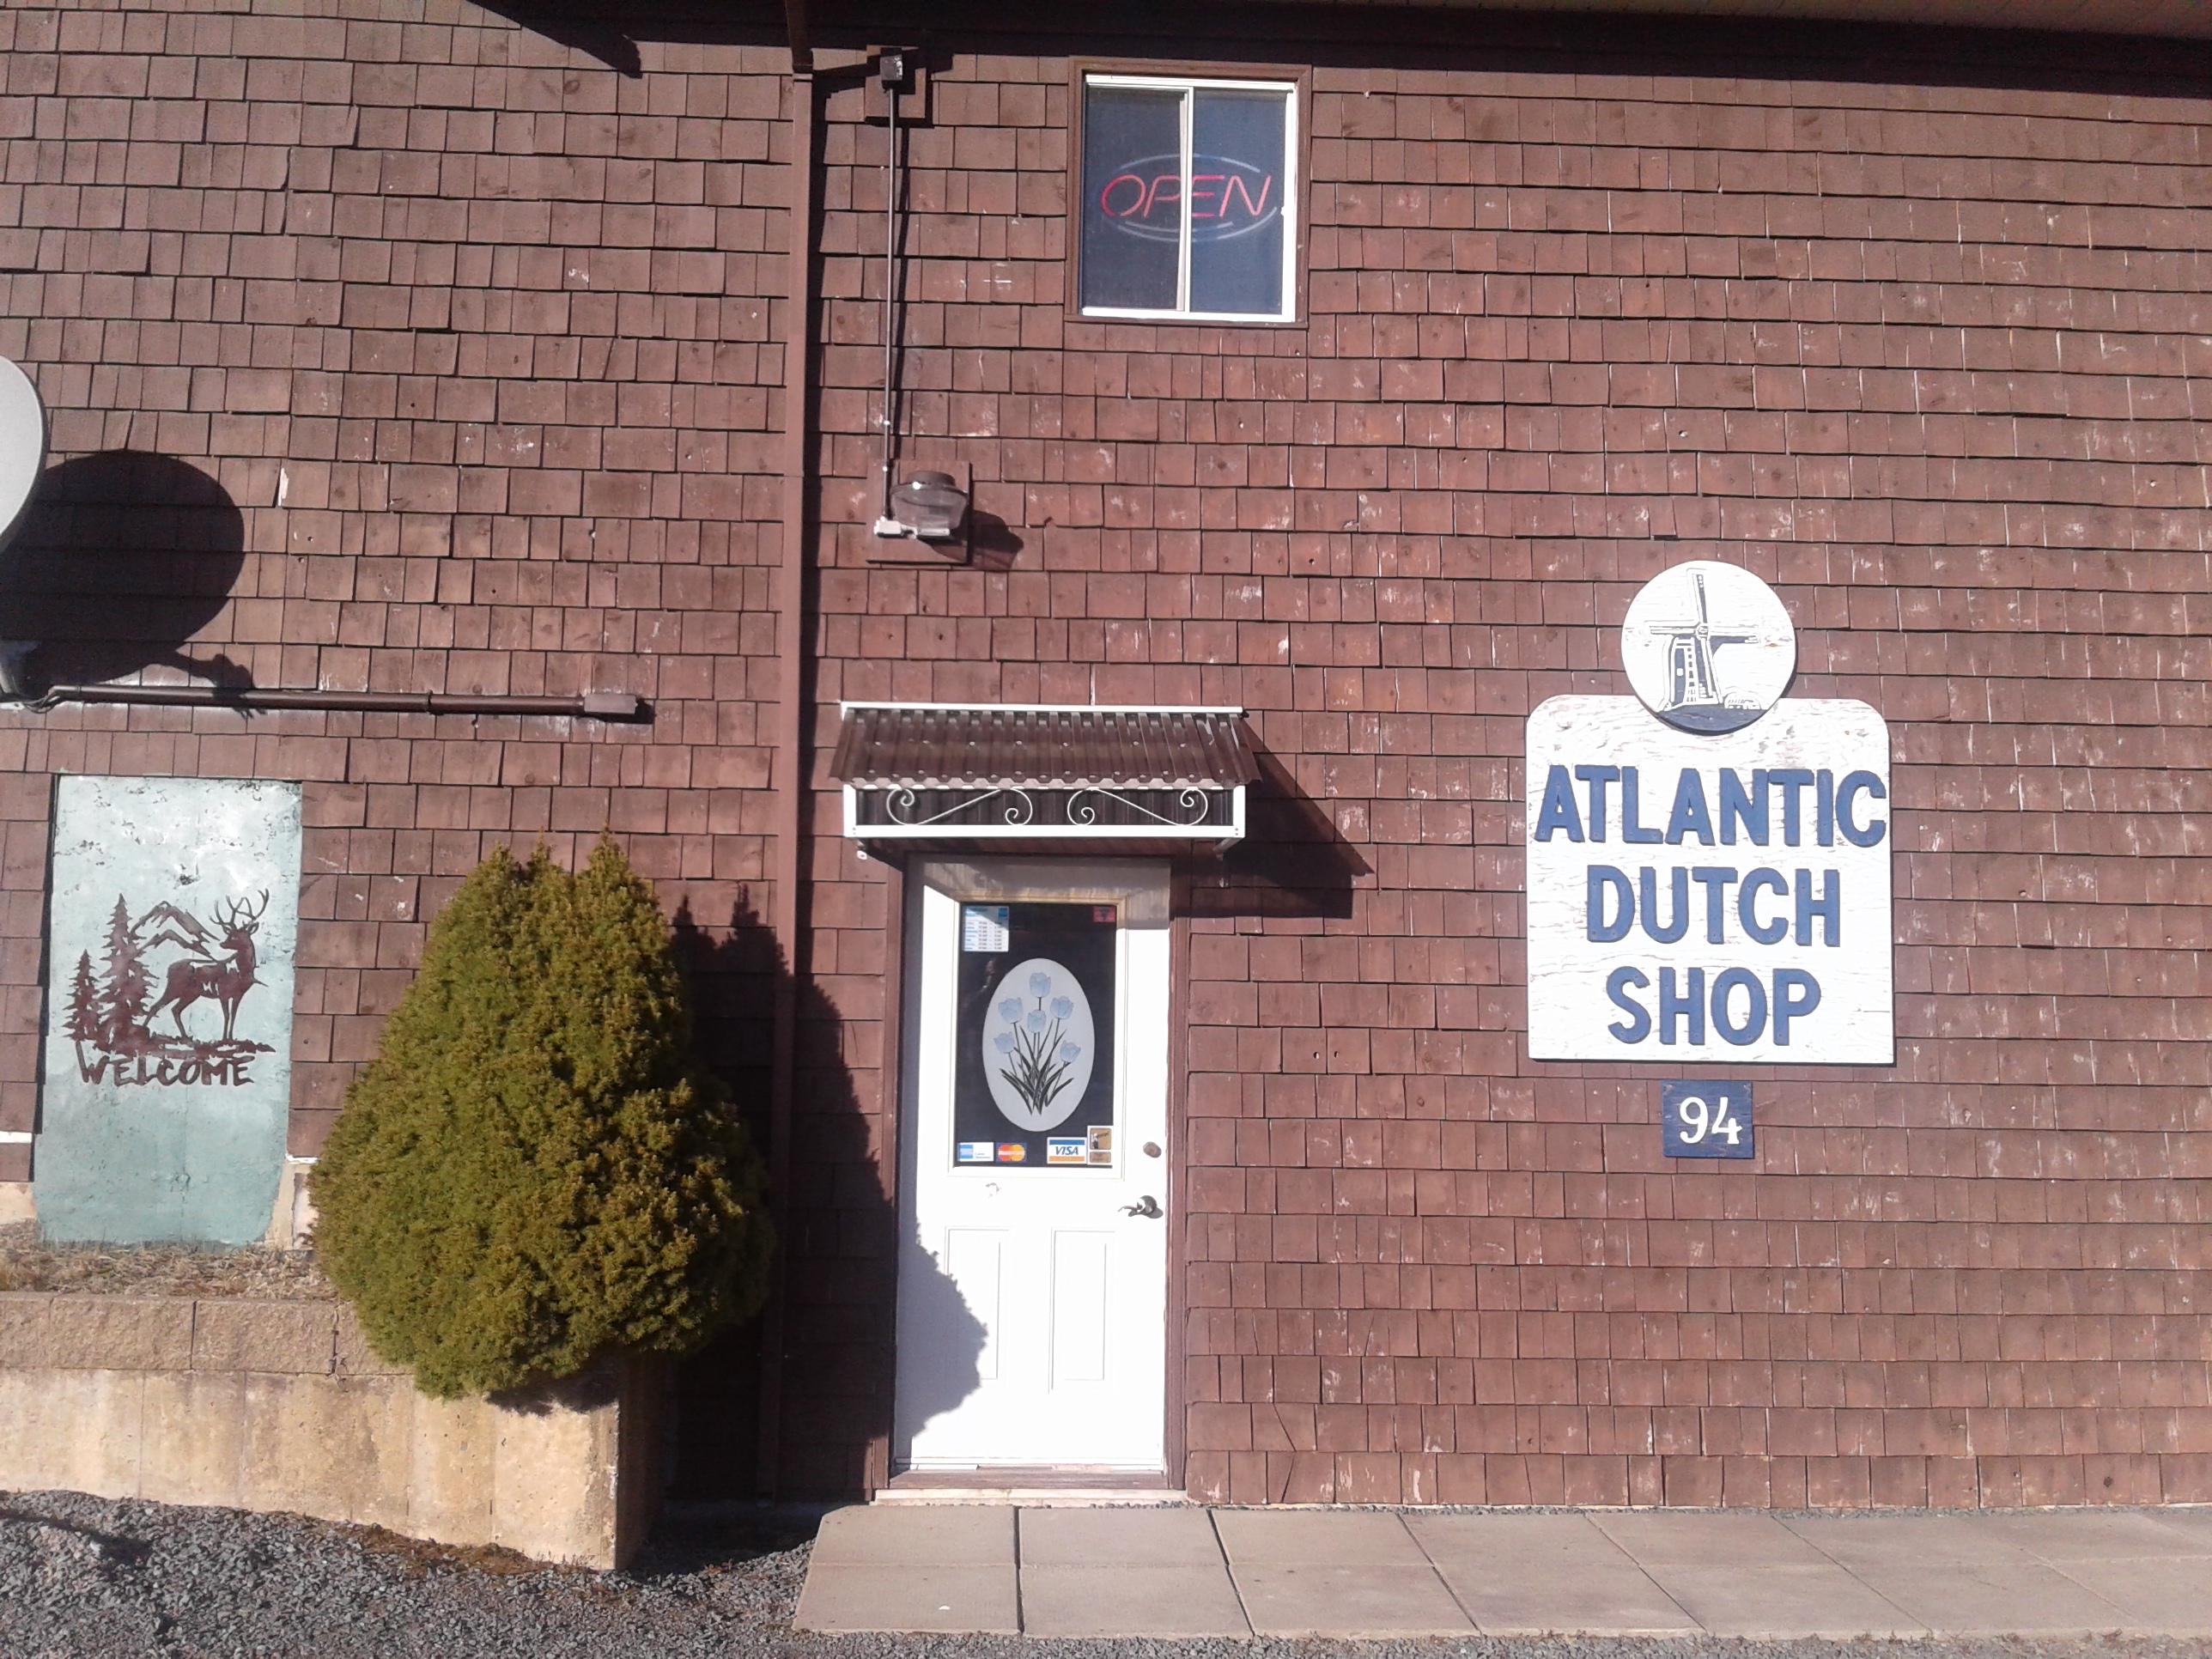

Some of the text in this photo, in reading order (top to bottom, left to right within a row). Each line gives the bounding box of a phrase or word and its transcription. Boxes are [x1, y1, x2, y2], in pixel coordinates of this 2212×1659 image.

[1102, 174, 1271, 216] OPEN
[1534, 765, 1887, 848] ATLANTIC
[1587, 865, 1840, 947] DUTCH
[1606, 966, 1821, 1046] SHOP
[76, 1041, 254, 1086] WELCOME
[1678, 1096, 1743, 1145] 94
[1054, 1146, 1079, 1156] VISA
